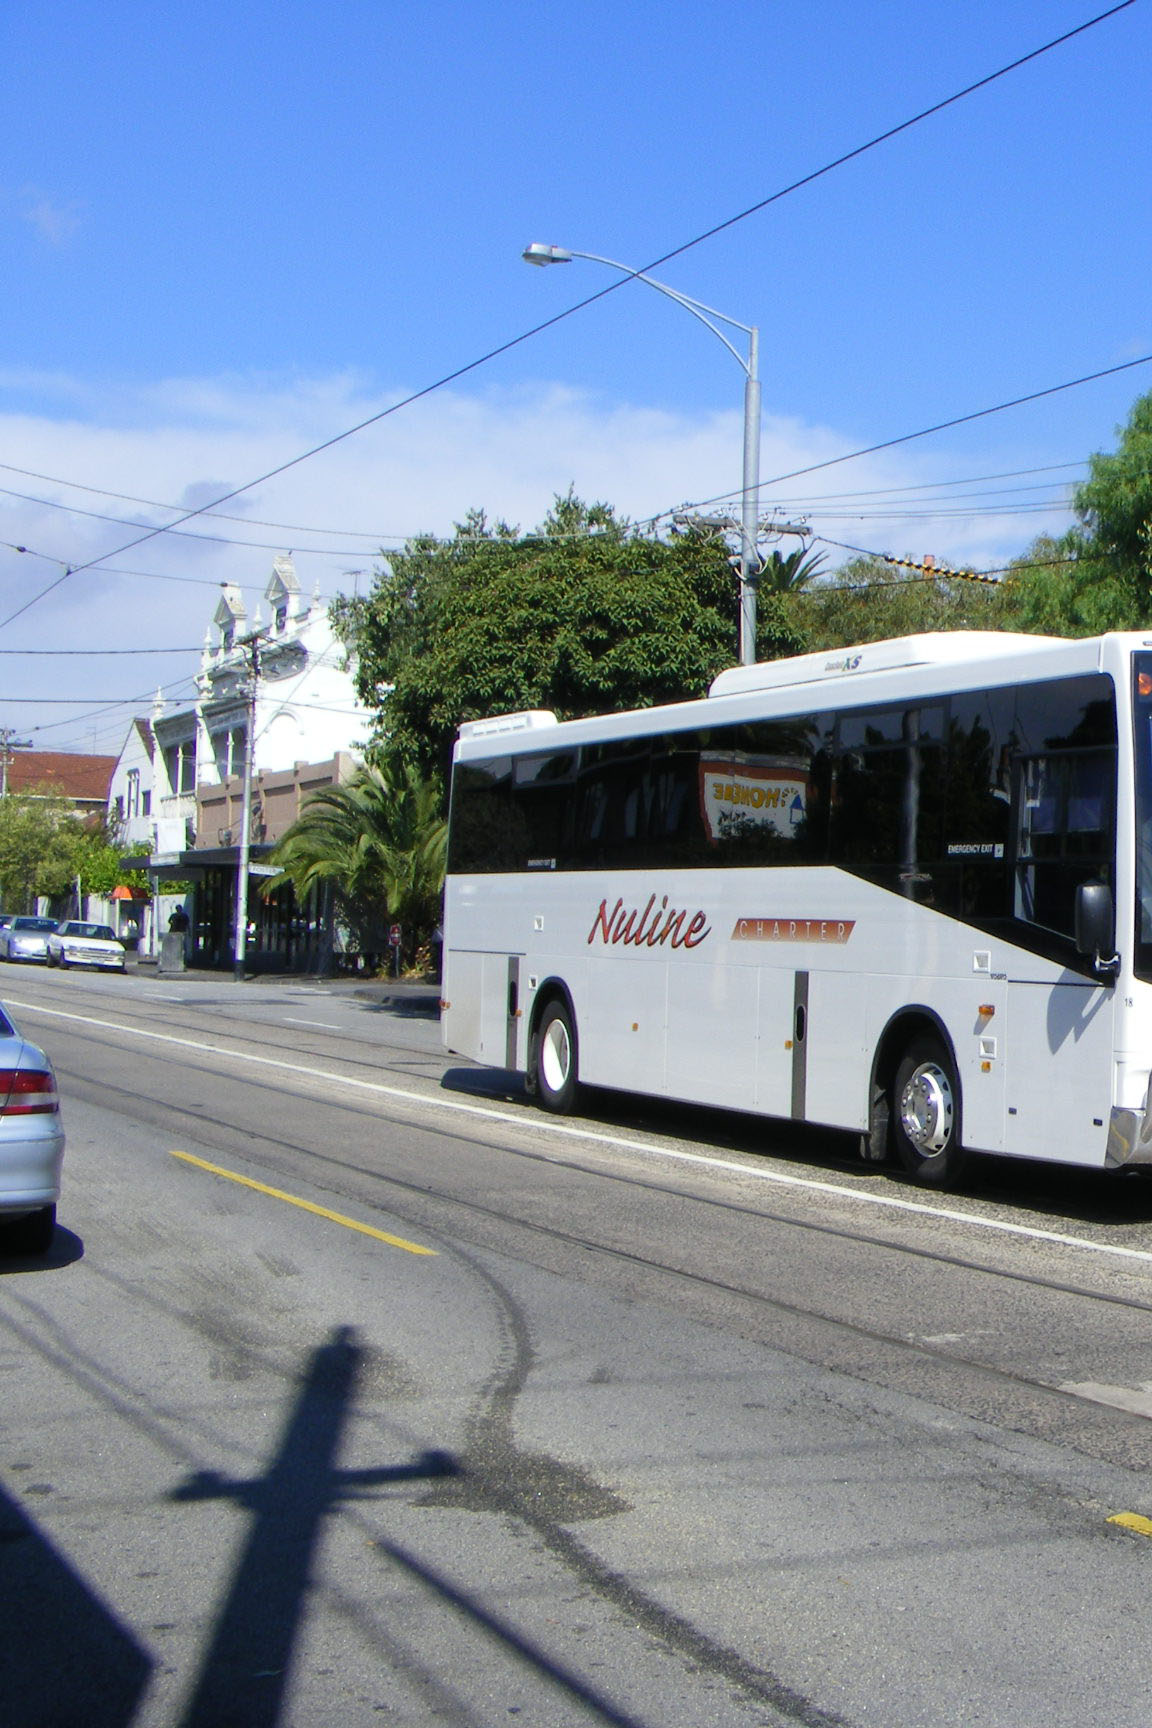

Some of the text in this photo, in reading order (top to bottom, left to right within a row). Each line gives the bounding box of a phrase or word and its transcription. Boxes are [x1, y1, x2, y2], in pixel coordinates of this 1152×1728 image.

[948, 844, 980, 854] EMERGENCY
[588, 893, 712, 949] Nuline
[739, 920, 845, 940] CHARTER
